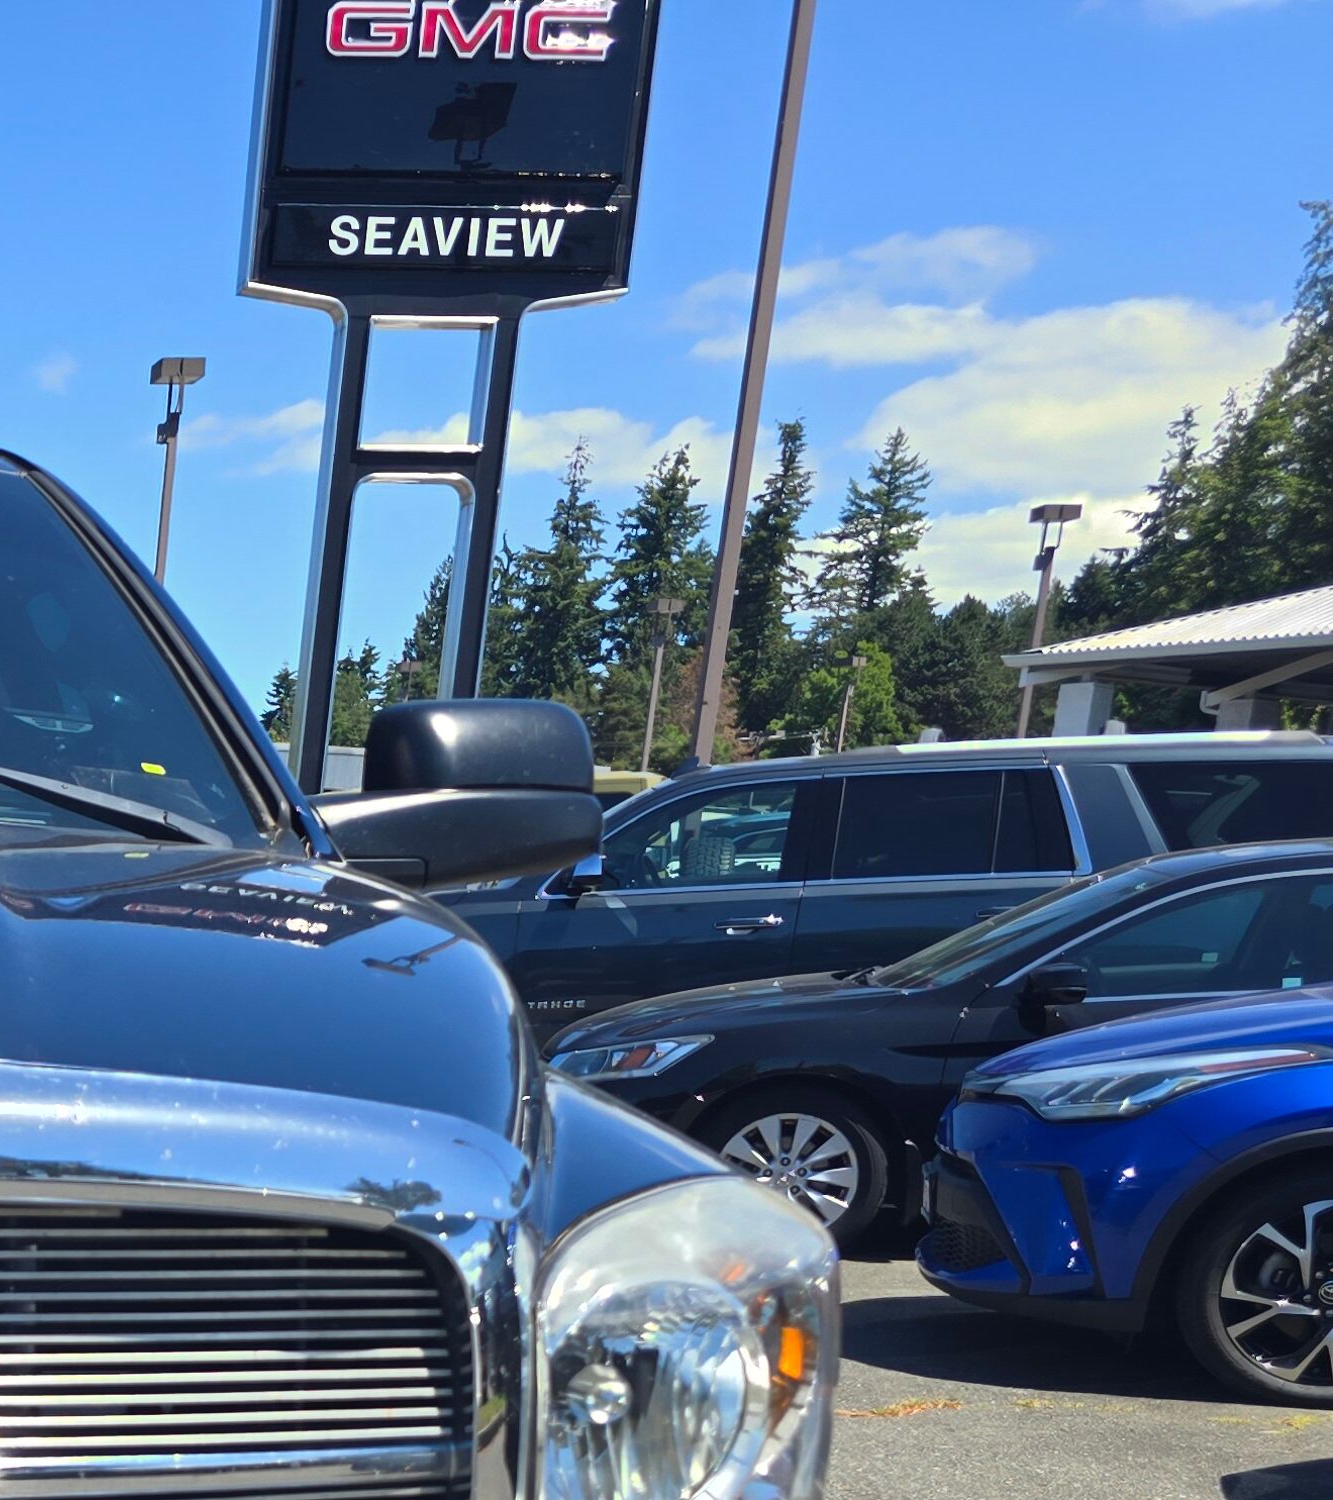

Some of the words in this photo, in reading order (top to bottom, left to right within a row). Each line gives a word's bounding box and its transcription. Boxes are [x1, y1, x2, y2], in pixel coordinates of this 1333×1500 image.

[326, 0, 614, 61] GMC
[328, 215, 565, 258] SEAVIEW
[527, 1000, 586, 1009] TAHOE
